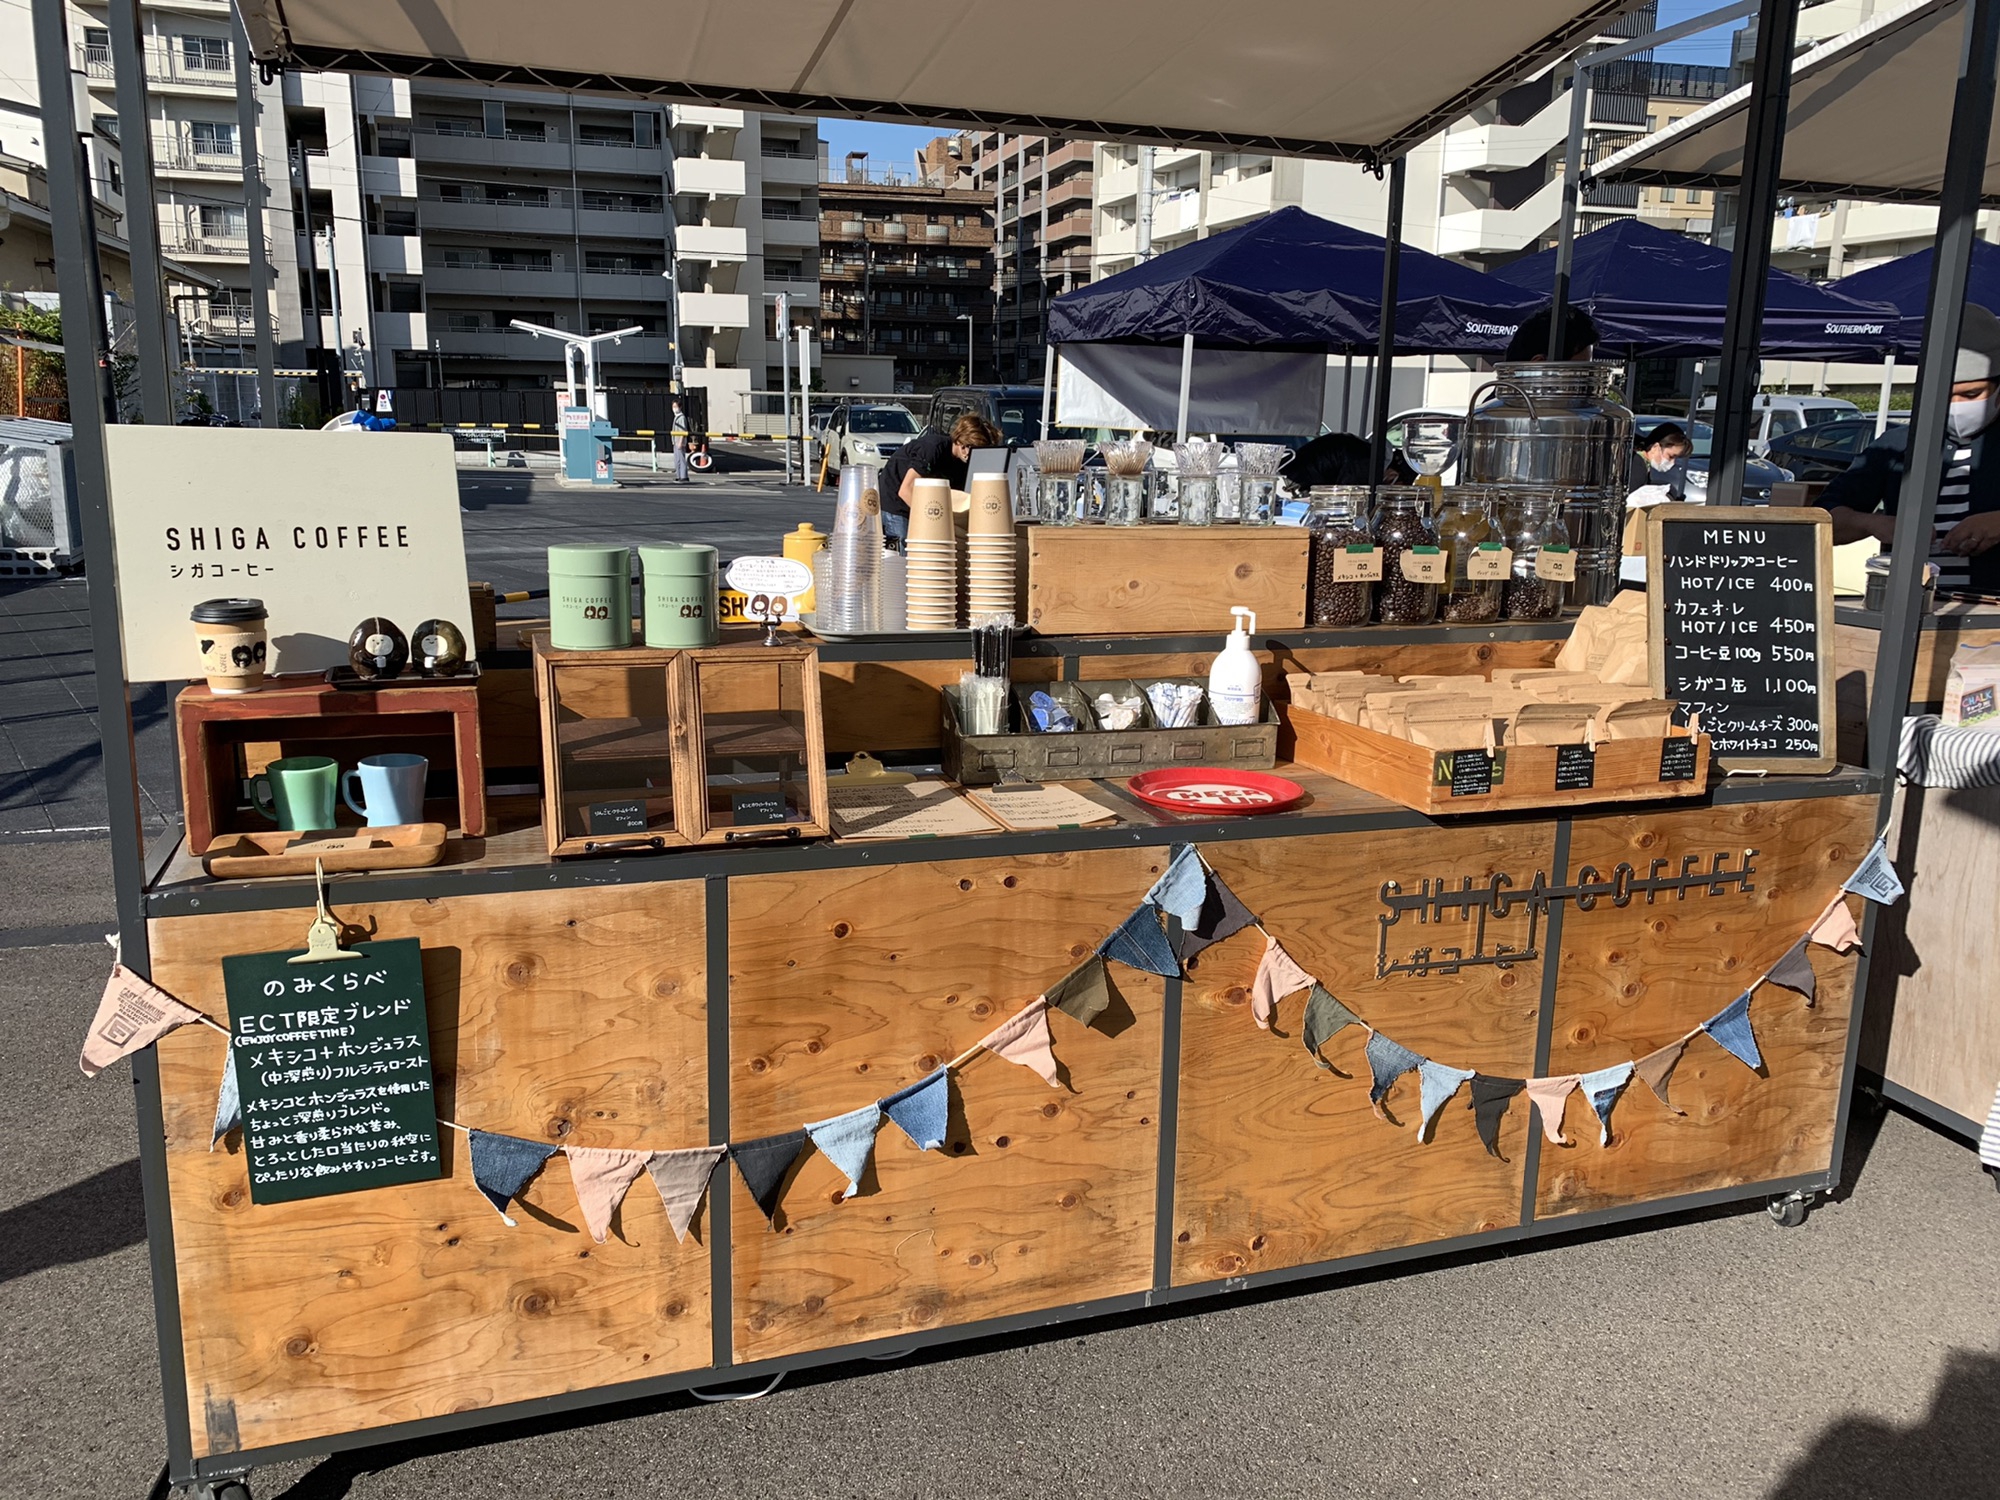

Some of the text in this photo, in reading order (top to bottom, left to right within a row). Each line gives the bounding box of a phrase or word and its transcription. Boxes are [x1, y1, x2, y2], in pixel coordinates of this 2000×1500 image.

[1465, 321, 1519, 335] SOUTHERNP
[1824, 322, 1884, 334] SOUTHERNPORT
[165, 524, 411, 552] SHIGA COFFEE
[1703, 529, 1767, 545] MENU
[1669, 554, 1798, 569] ハンドドリップコーヒー
[170, 562, 275, 579] シガコーヒー
[1769, 576, 1814, 592] 400円
[1769, 617, 1816, 634] 450円
[1771, 645, 1815, 662] 550円
[1678, 675, 1747, 694] シガコ缶
[1962, 689, 1993, 708] CHALK
[1678, 701, 1730, 716] マフィン
[1786, 716, 1819, 732] 300円
[1785, 738, 1818, 752] 250円
[1379, 848, 1762, 926] SHIGA COFFEE
[263, 969, 388, 997] のみくらべ
[119, 987, 138, 1001] EASY
[118, 1008, 143, 1026] REMAKE
[246, 1081, 431, 1114] メキシコとホンジュラスを使用した
